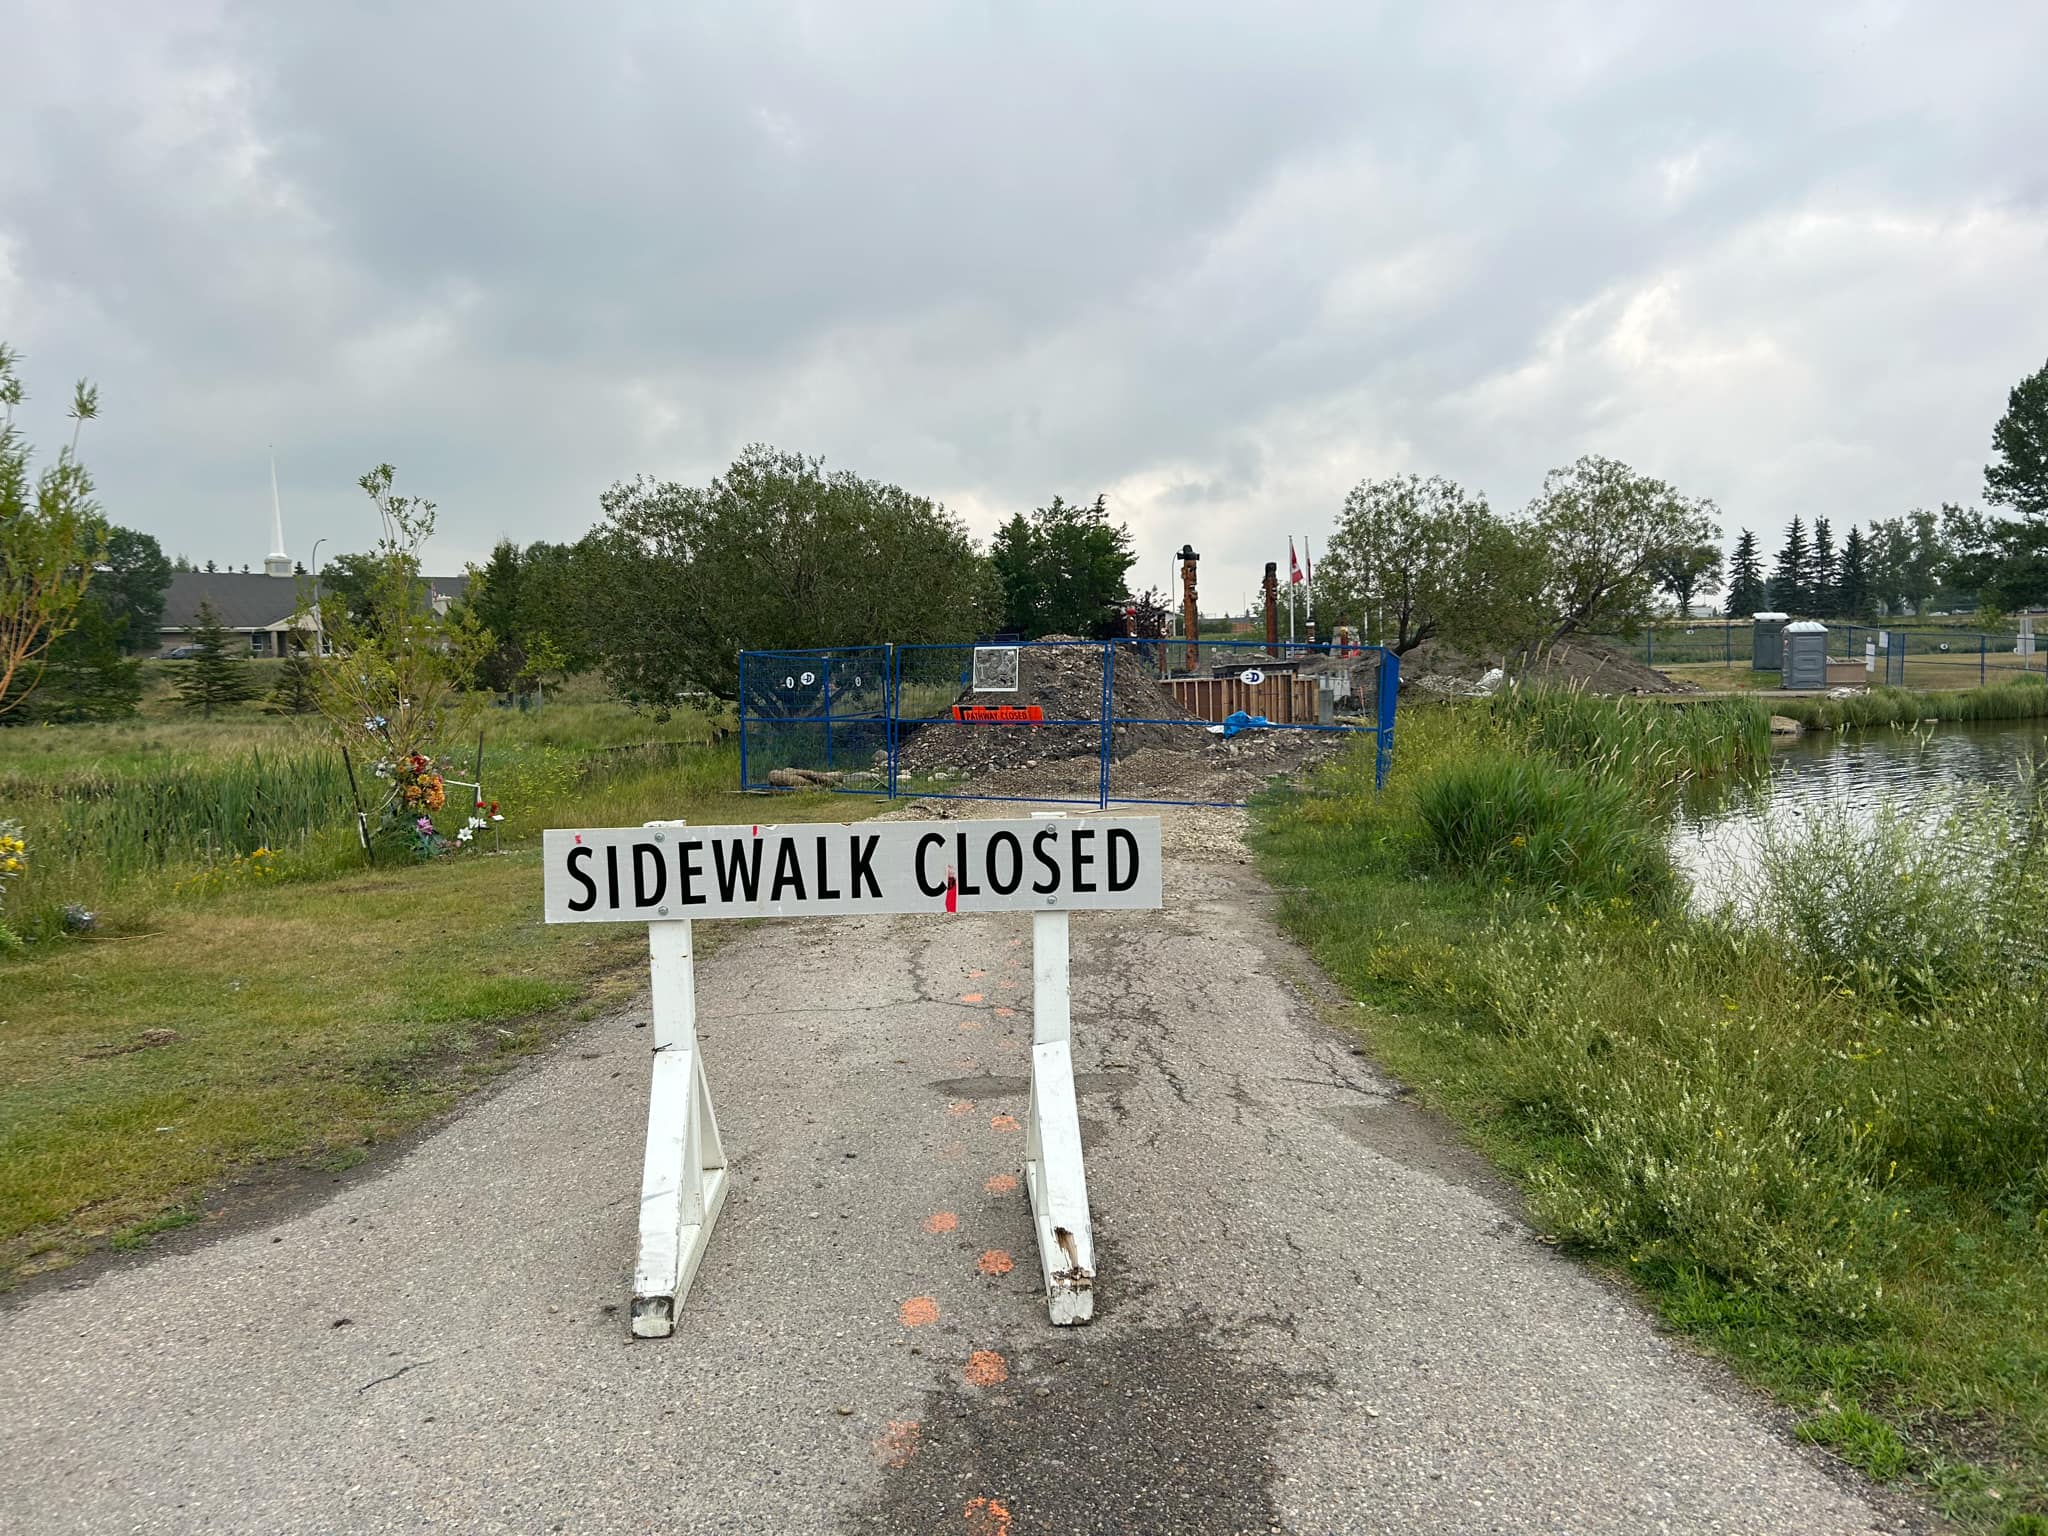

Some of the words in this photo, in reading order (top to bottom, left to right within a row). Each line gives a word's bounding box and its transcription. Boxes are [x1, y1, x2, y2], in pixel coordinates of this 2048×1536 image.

[966, 711, 998, 720] PATHWAY
[1001, 711, 1027, 720] CLOSED
[567, 835, 883, 912] SIDEWALK
[915, 828, 1140, 898] CLOSED
